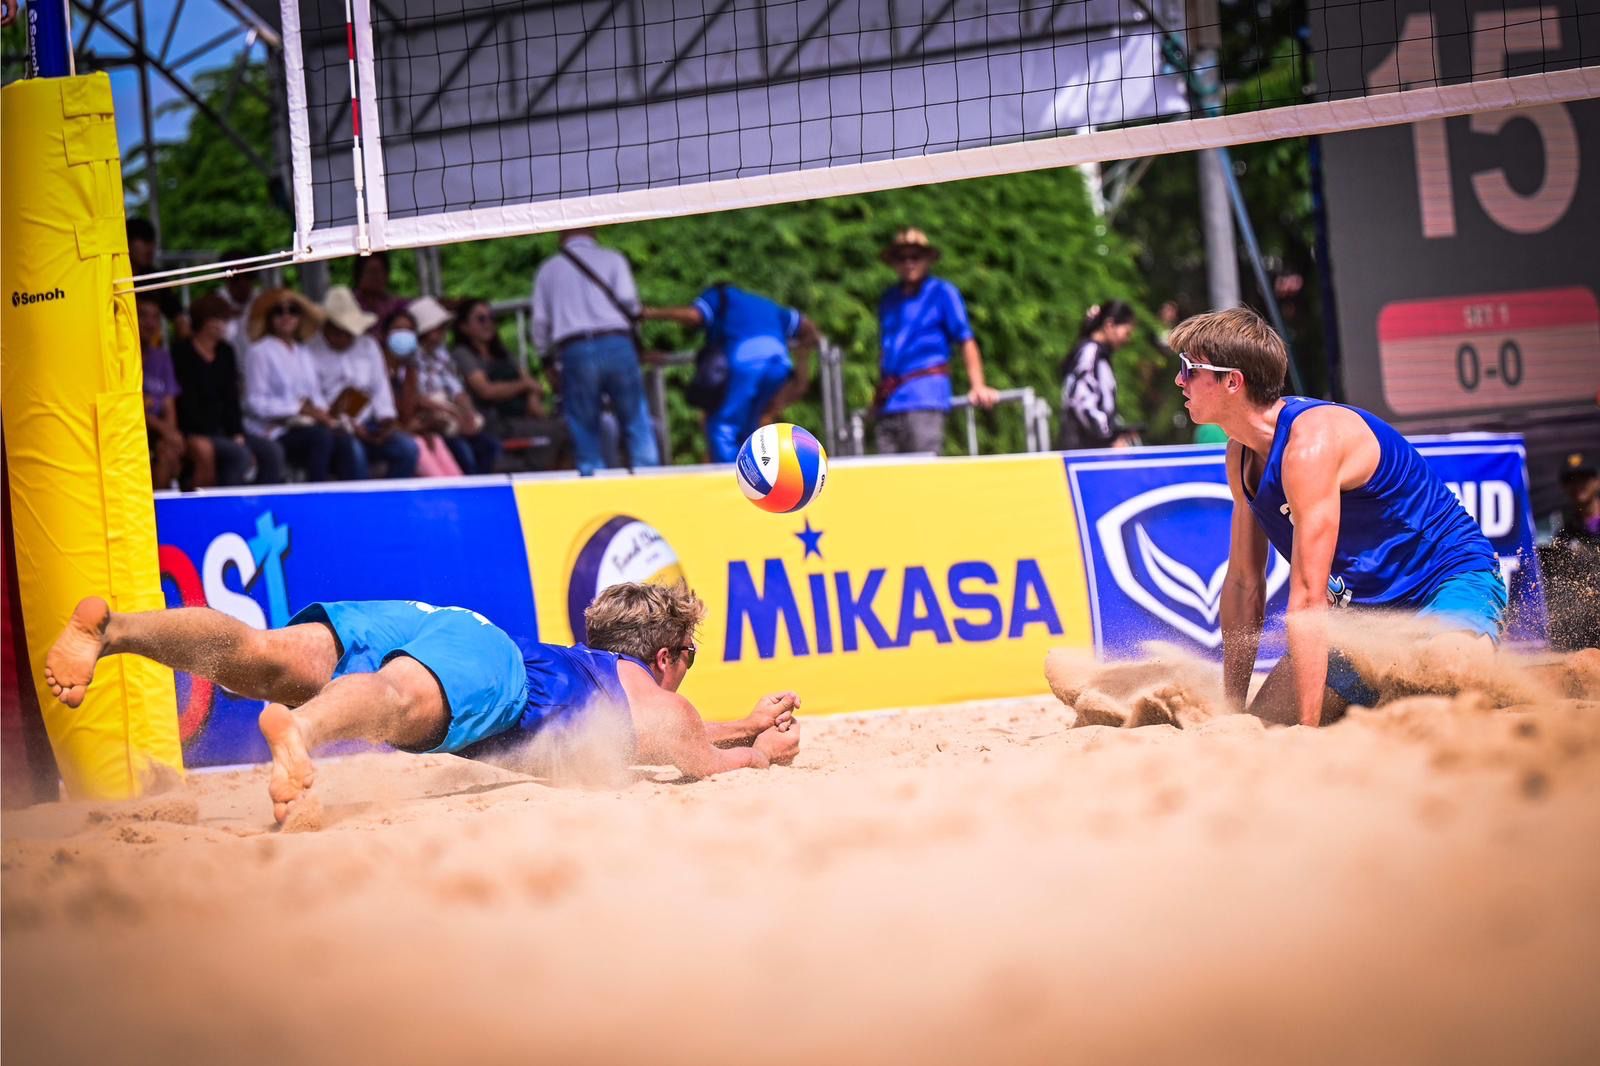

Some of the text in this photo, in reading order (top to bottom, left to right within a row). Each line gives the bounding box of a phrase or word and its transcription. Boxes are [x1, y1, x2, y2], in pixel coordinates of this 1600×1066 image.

[1366, 5, 1581, 240] 15
[21, 288, 65, 305] Senoh
[1463, 304, 1494, 329] SET
[1456, 339, 1524, 391] 0-0
[723, 557, 1065, 663] MIKASA
